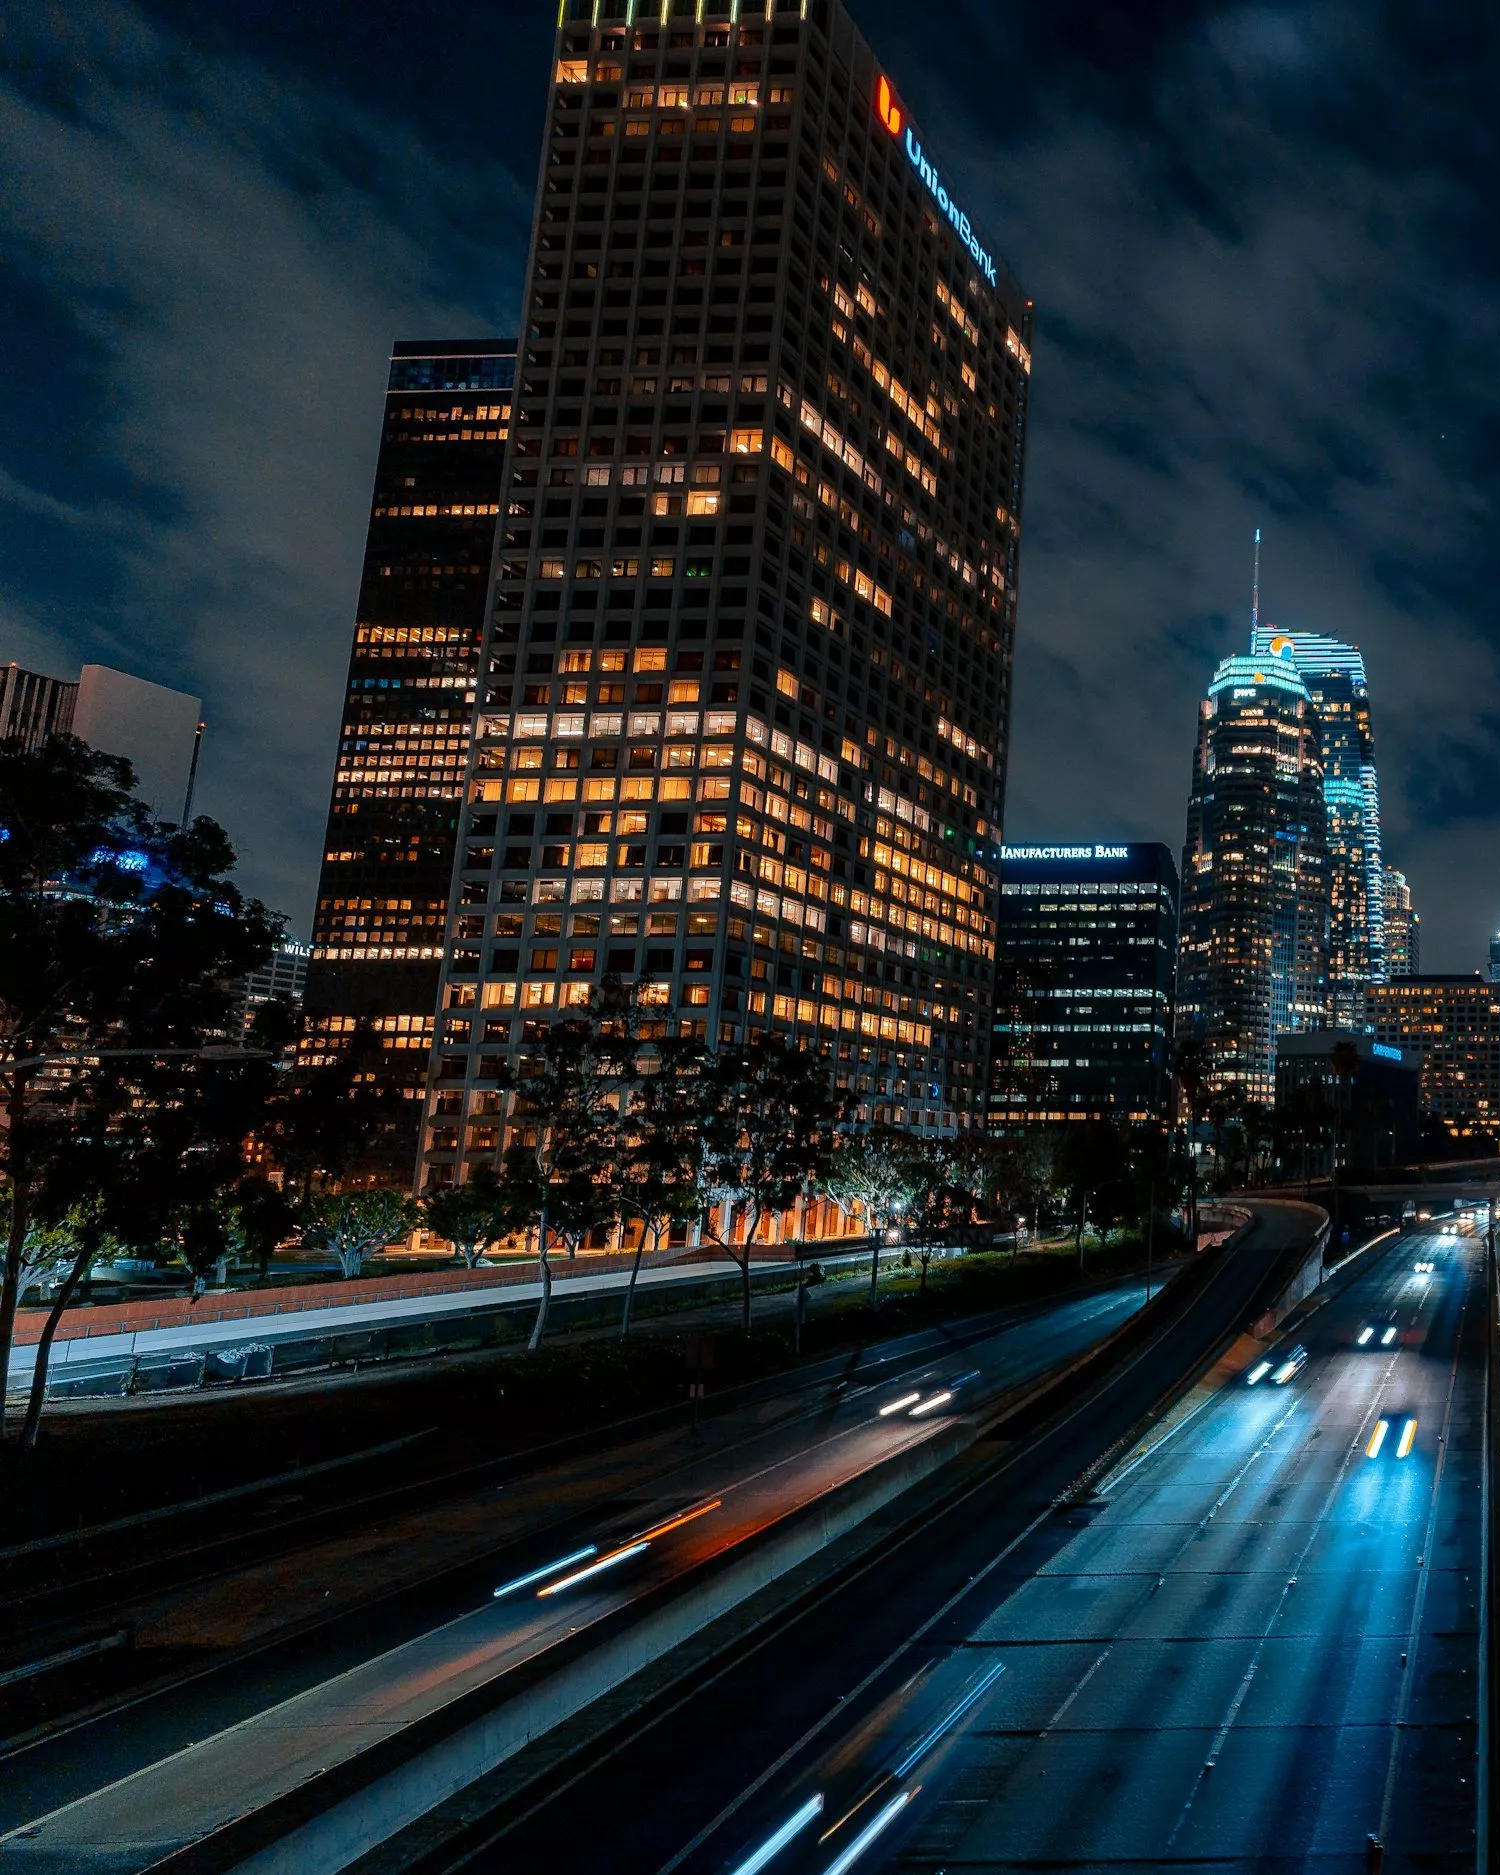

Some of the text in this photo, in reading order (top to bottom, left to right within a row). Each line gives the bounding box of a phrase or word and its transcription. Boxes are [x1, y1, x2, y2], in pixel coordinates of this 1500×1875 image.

[905, 127, 997, 287] UnionBank
[1234, 688, 1256, 699] pwc
[1094, 845, 1128, 858] BANK
